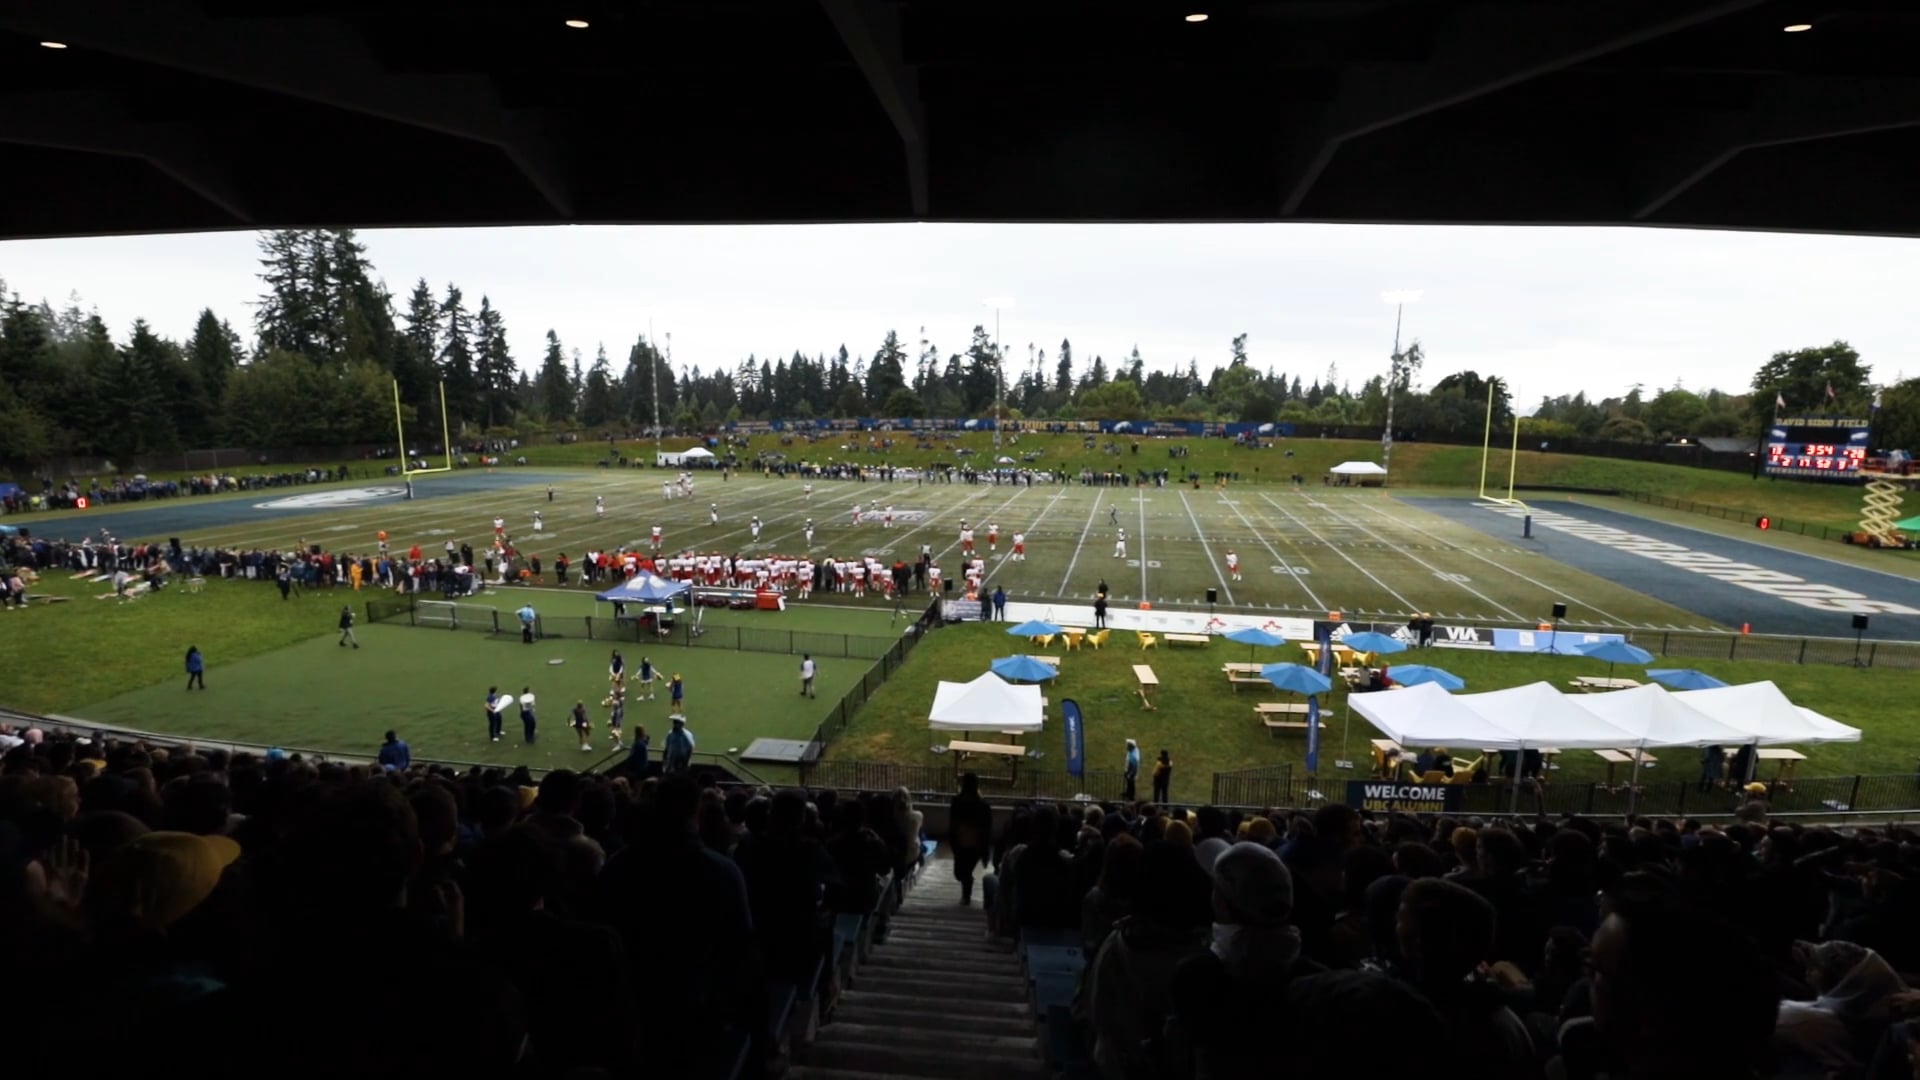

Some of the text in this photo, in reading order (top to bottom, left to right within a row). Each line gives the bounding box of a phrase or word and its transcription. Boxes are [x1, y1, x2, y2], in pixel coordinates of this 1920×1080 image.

[1446, 626, 1479, 641] VIA
[1364, 784, 1446, 800] WELCOME
[1363, 800, 1444, 812] UBC ALUMNI
